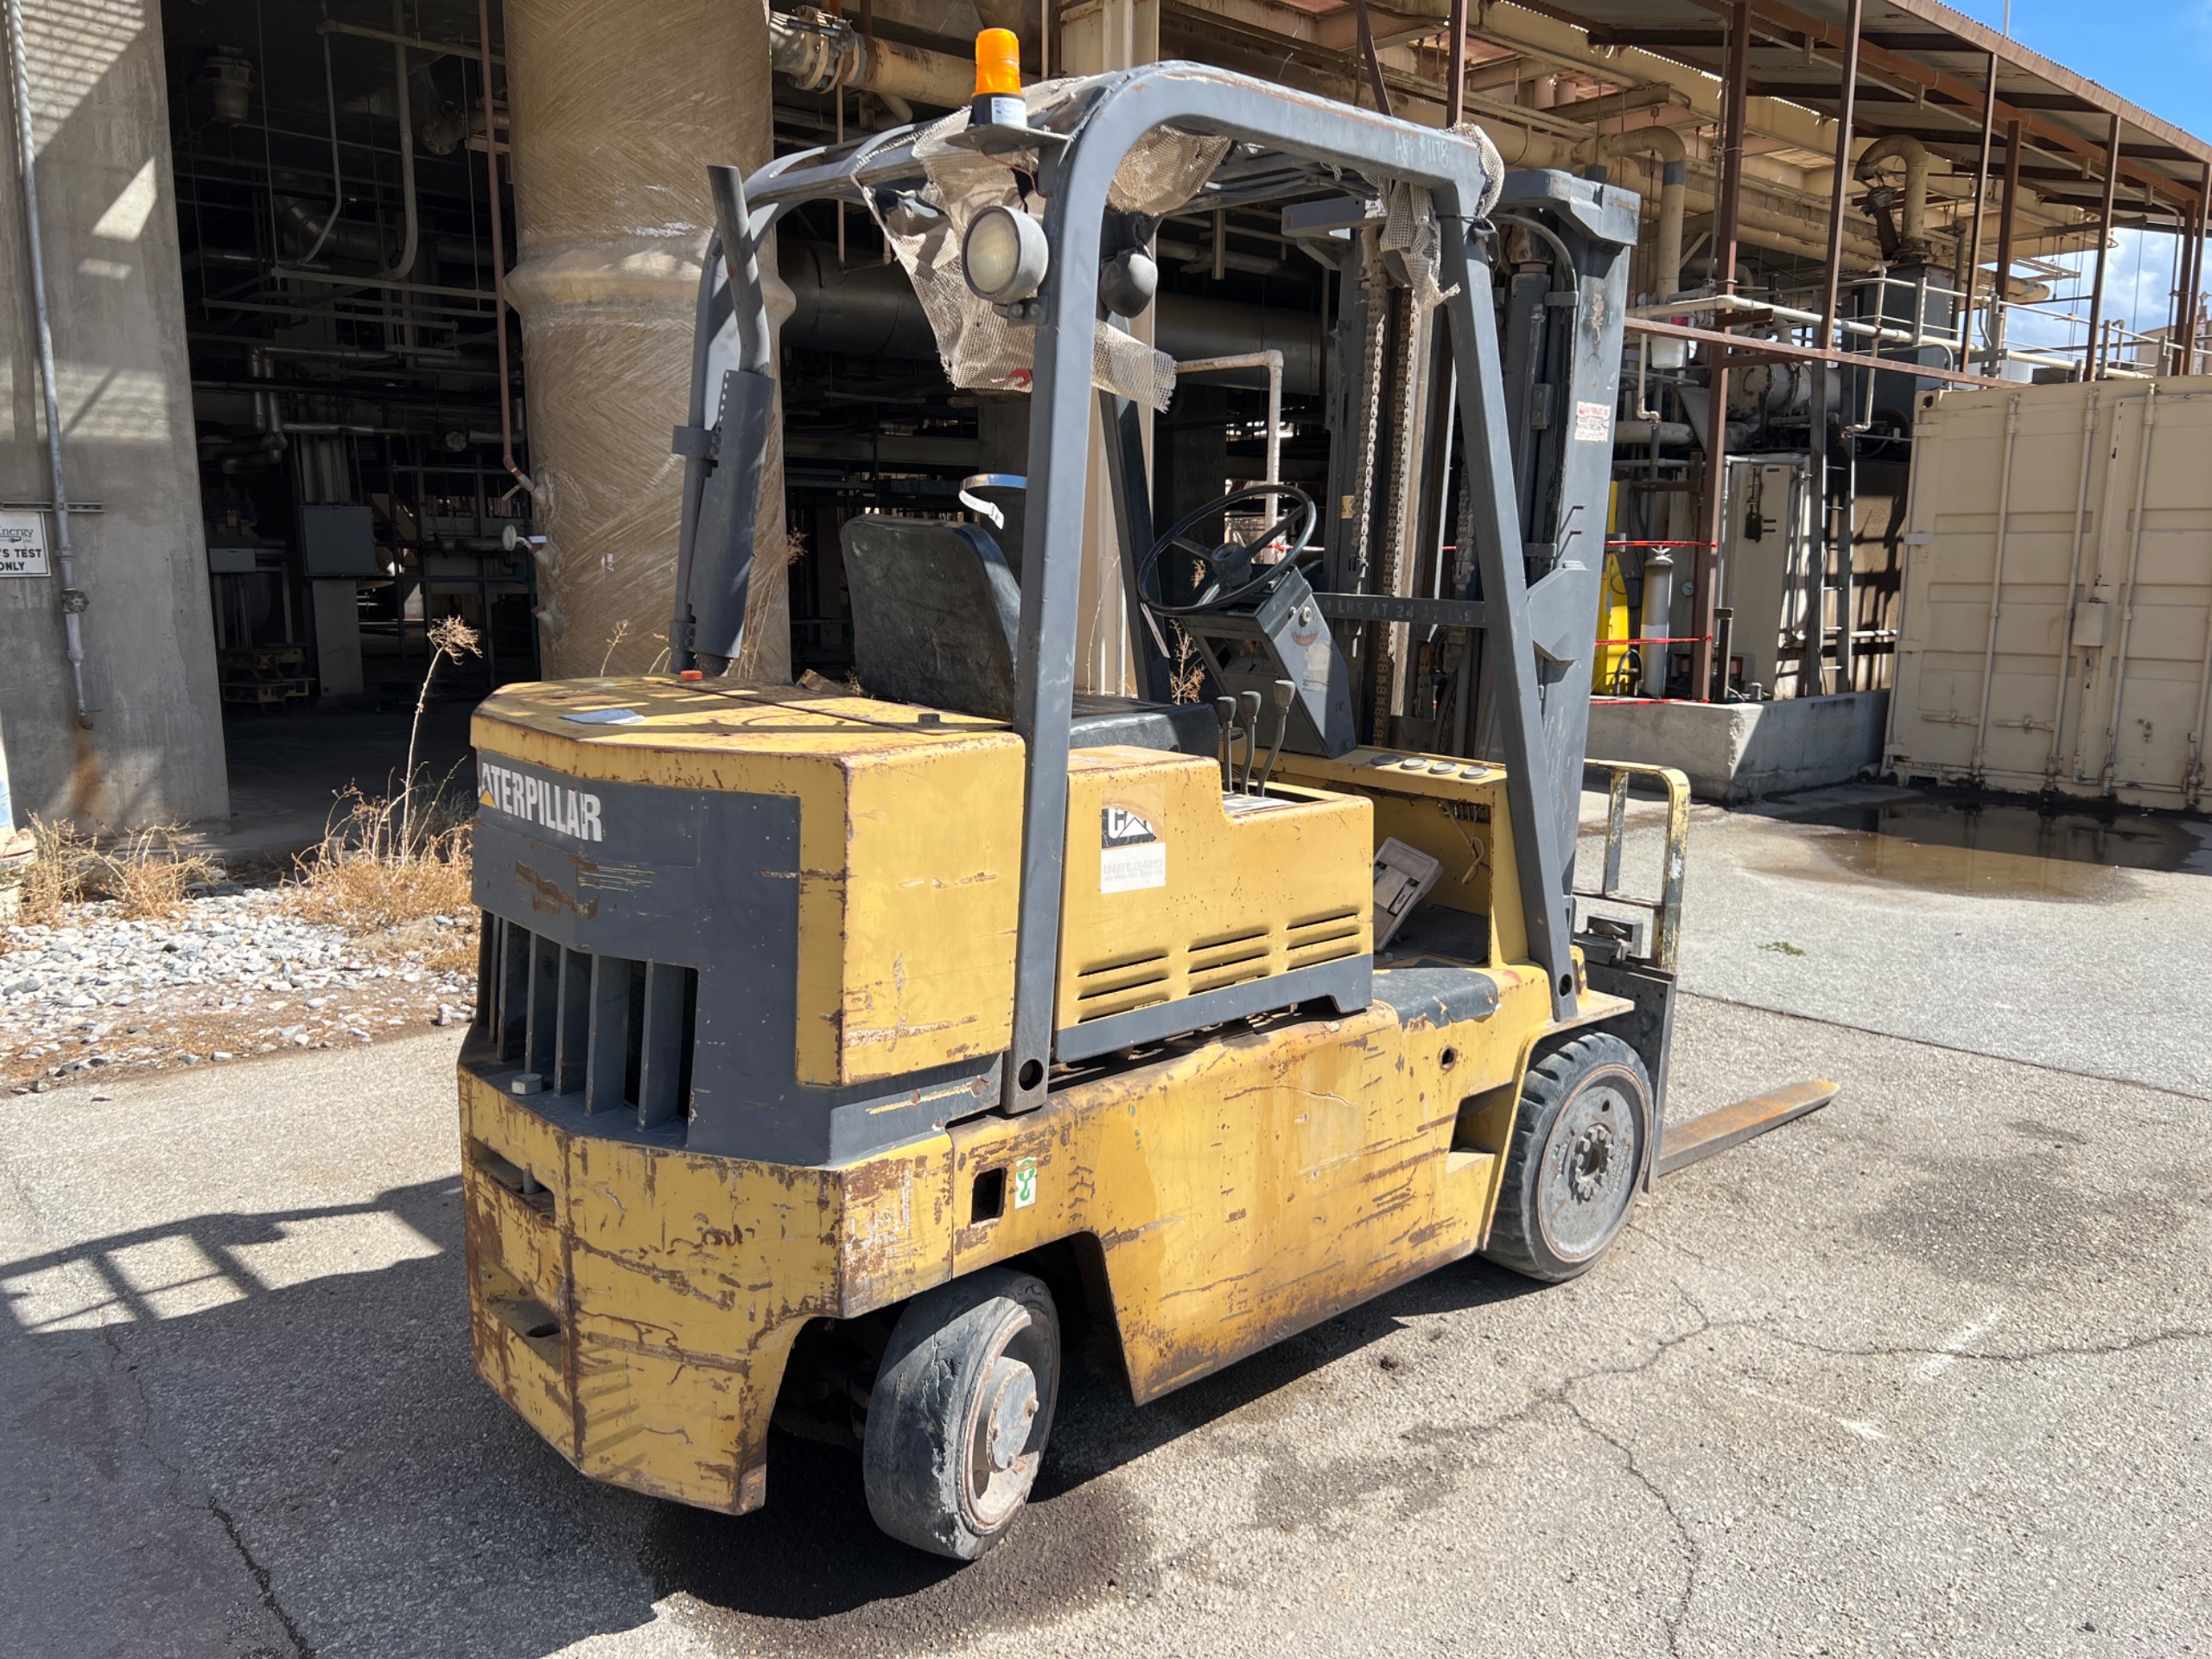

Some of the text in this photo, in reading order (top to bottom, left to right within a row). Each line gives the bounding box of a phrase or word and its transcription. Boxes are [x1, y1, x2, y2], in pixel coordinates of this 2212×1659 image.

[0, 526, 34, 538] nergy
[14, 549, 41, 558] TEST
[1338, 599, 1363, 614] LBS
[1370, 601, 1389, 617] AT
[1395, 604, 1414, 619] 24
[478, 762, 603, 842] ATERPILLAR
